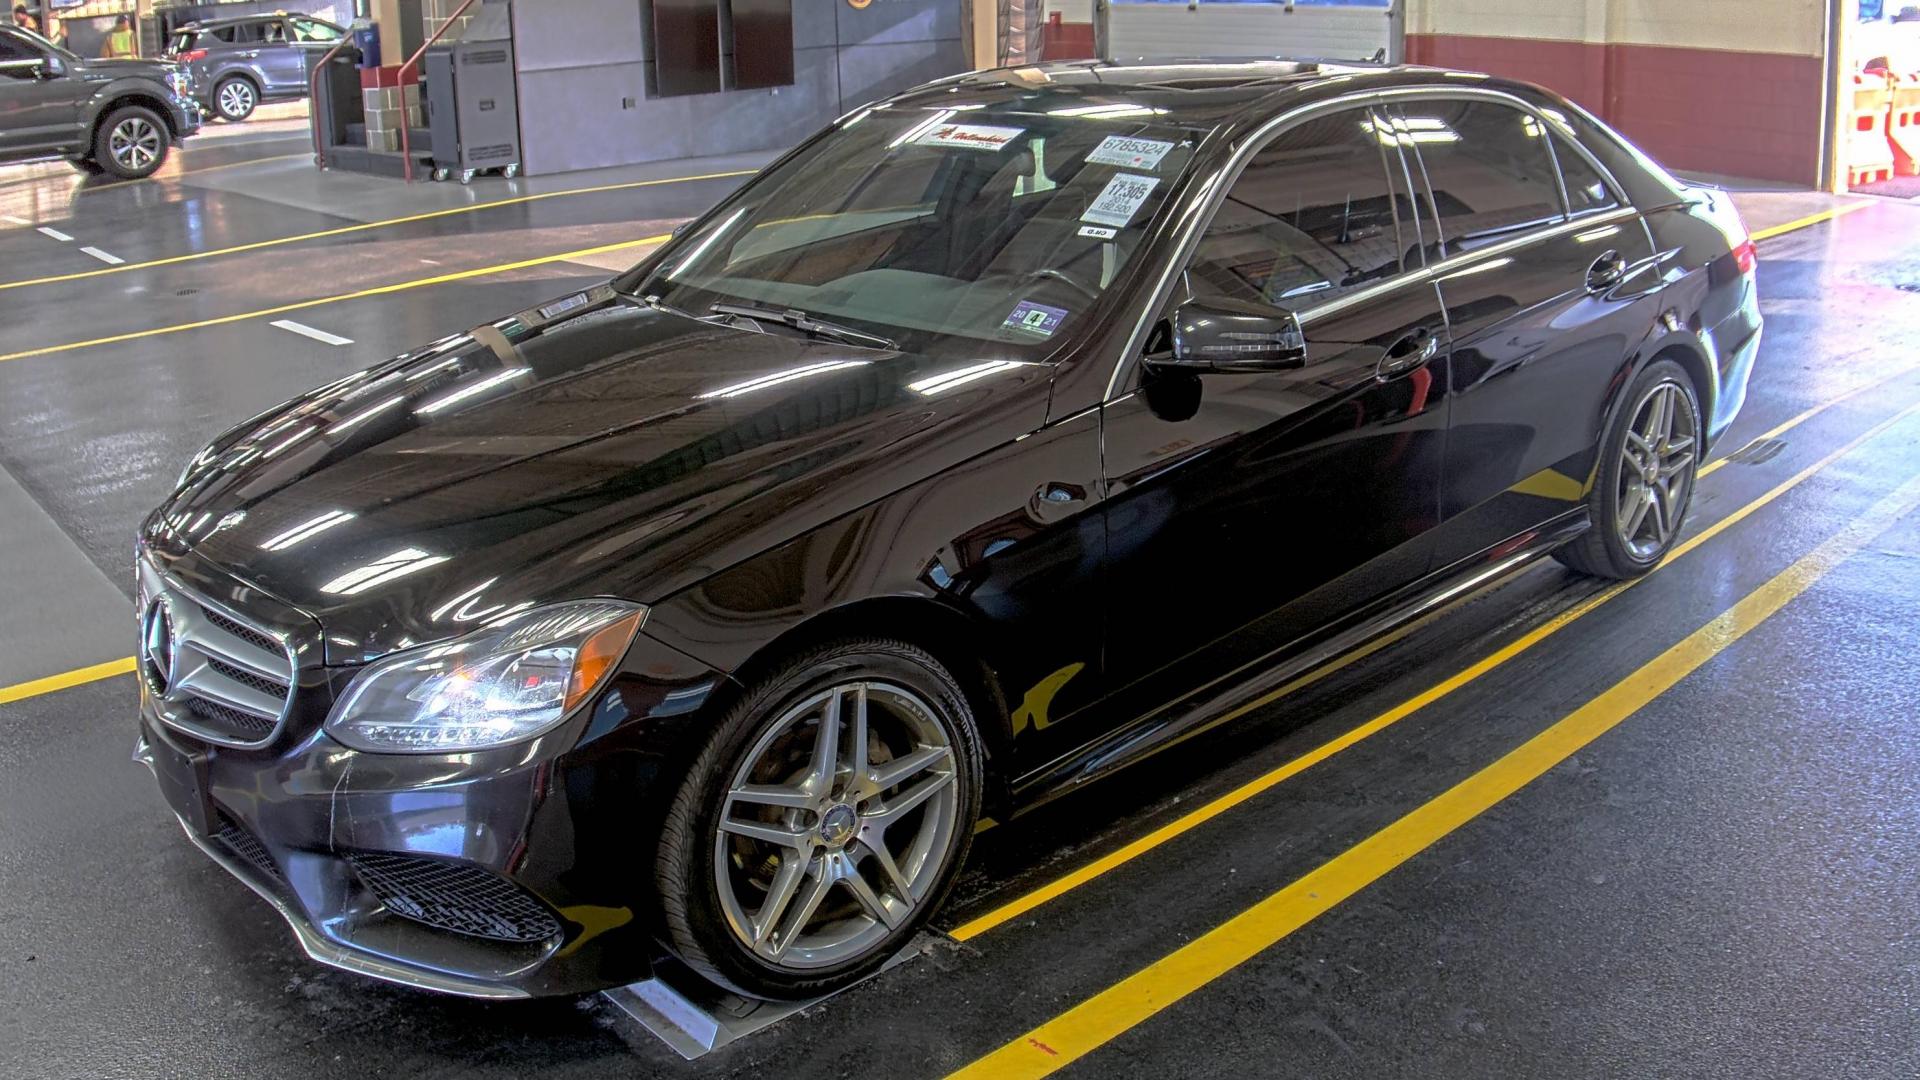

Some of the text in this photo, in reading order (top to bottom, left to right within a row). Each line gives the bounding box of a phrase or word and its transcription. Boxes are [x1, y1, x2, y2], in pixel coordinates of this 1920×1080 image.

[1102, 138, 1166, 155] 6785324
[1013, 309, 1058, 327] 20 4 21
